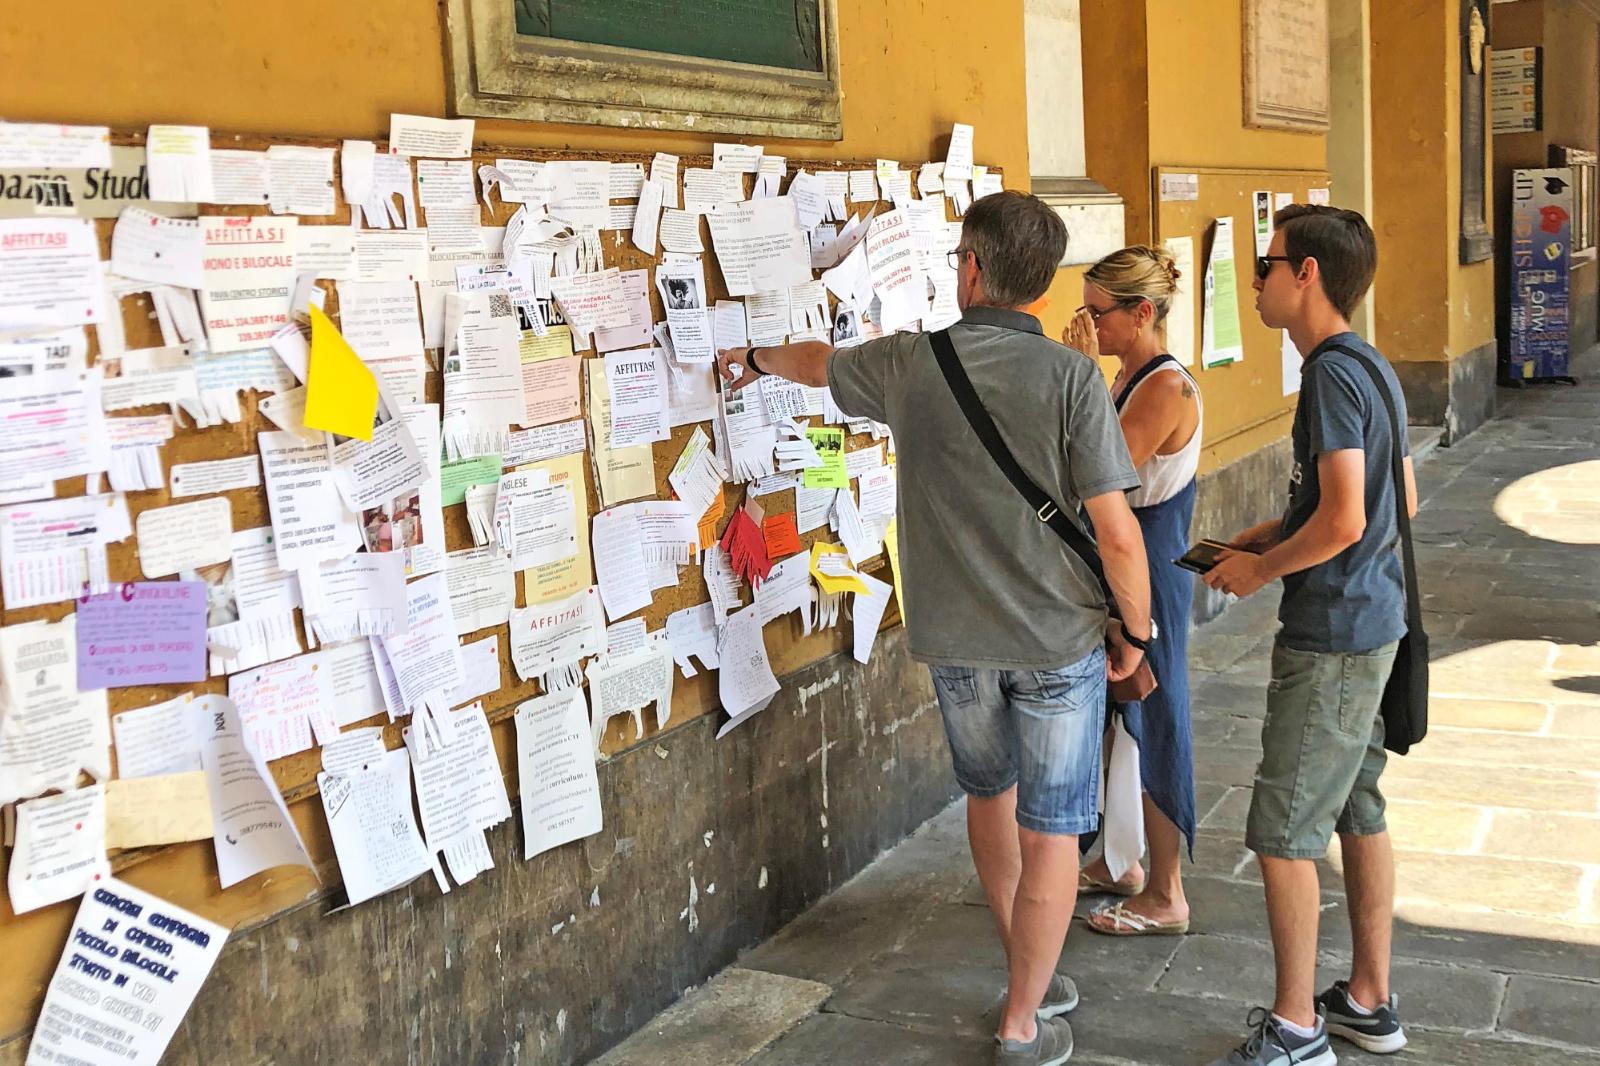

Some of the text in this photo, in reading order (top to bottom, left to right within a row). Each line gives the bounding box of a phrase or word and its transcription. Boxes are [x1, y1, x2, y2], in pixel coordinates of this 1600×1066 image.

[83, 165, 150, 200] Stud
[2, 232, 67, 247] AFFITTASI
[205, 228, 285, 241] AFFITTASI
[243, 256, 292, 268] BILOCALE
[1531, 291, 1545, 332] MUG
[614, 361, 656, 375] AFFITTASI
[530, 605, 584, 630] AFFITTASI
[102, 918, 119, 933] DI
[73, 928, 118, 958] PICCOLO
